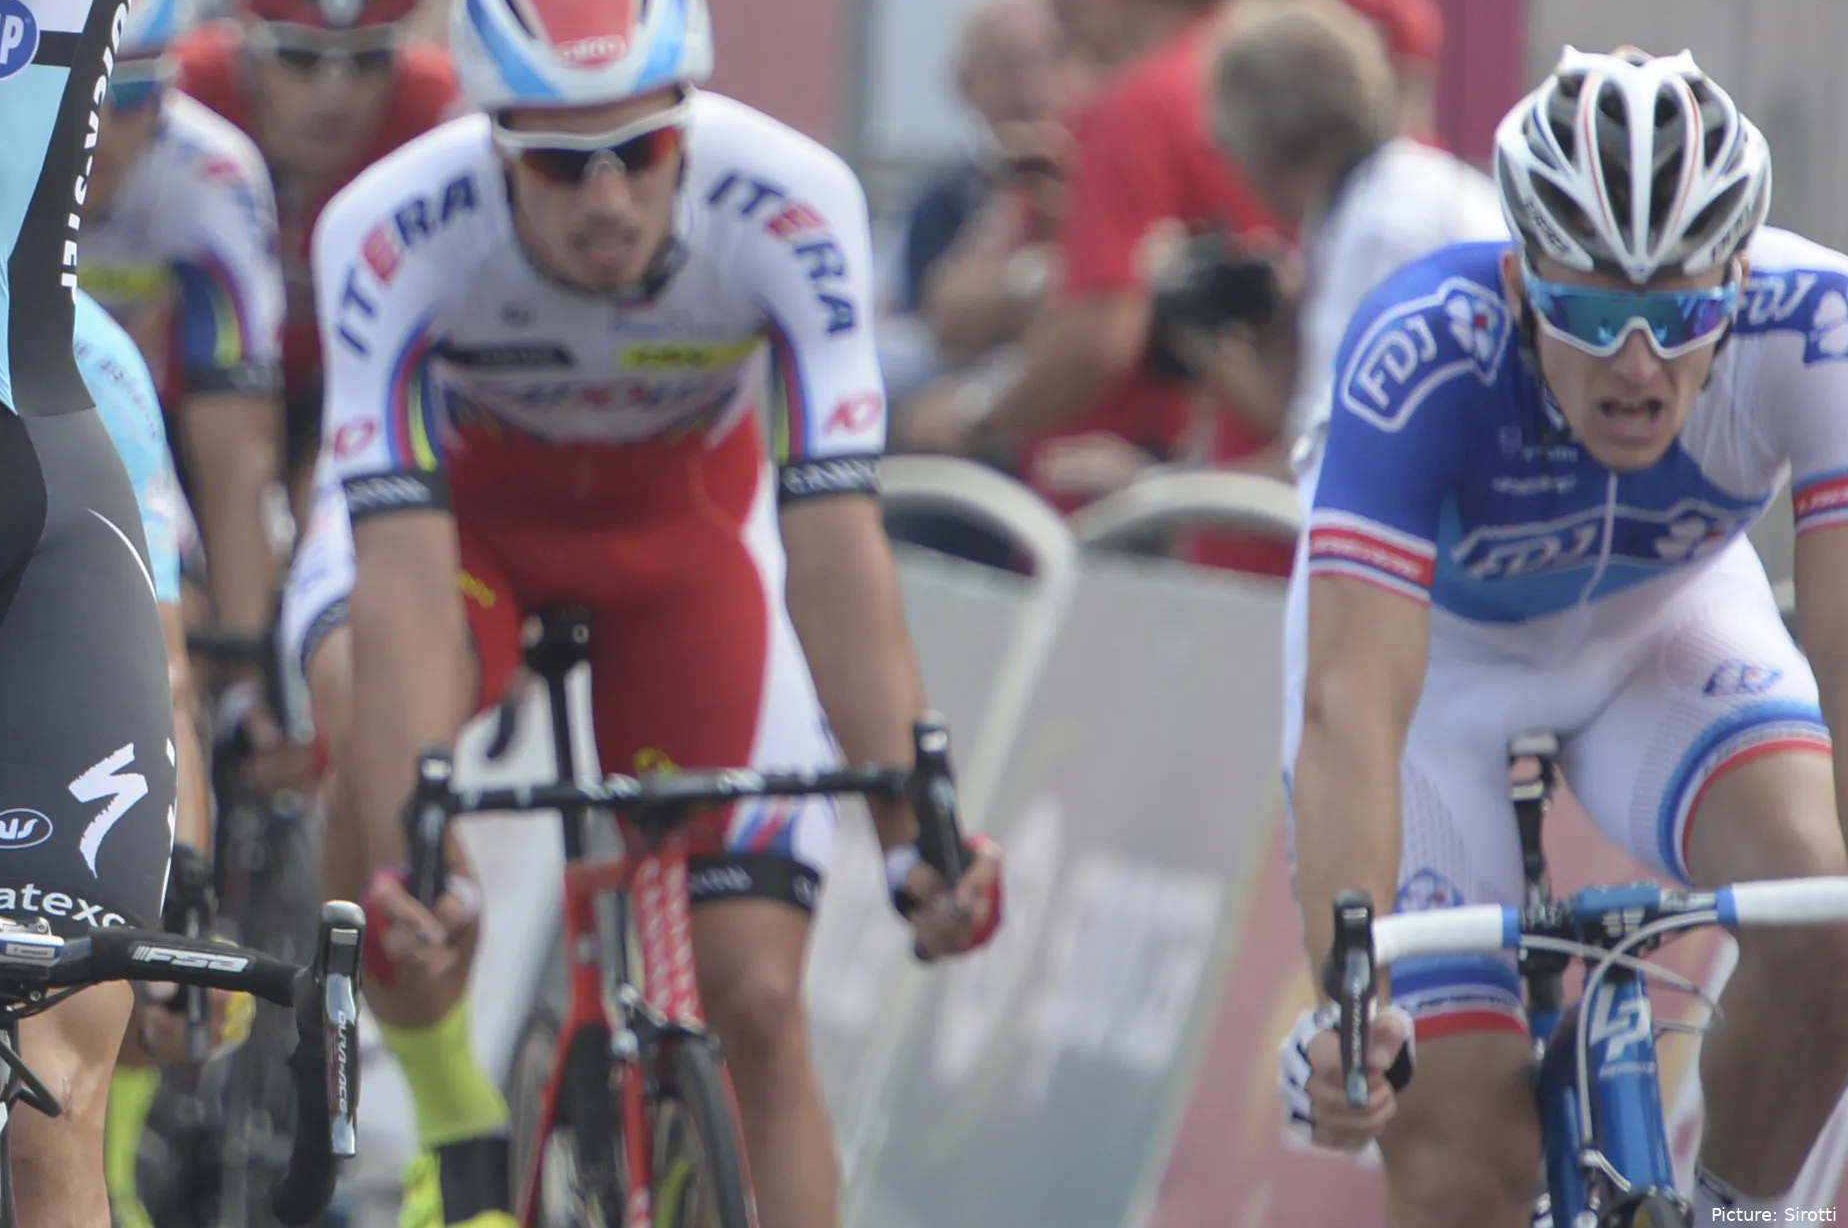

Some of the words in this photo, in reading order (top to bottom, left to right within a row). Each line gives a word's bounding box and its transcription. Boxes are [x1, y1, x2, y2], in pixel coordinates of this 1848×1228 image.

[337, 174, 477, 356] ITERA
[708, 174, 856, 334] ITERA
[1357, 314, 1438, 410] FDJ
[134, 945, 252, 973] FSA
[337, 1011, 350, 1114] DURA-ACE
